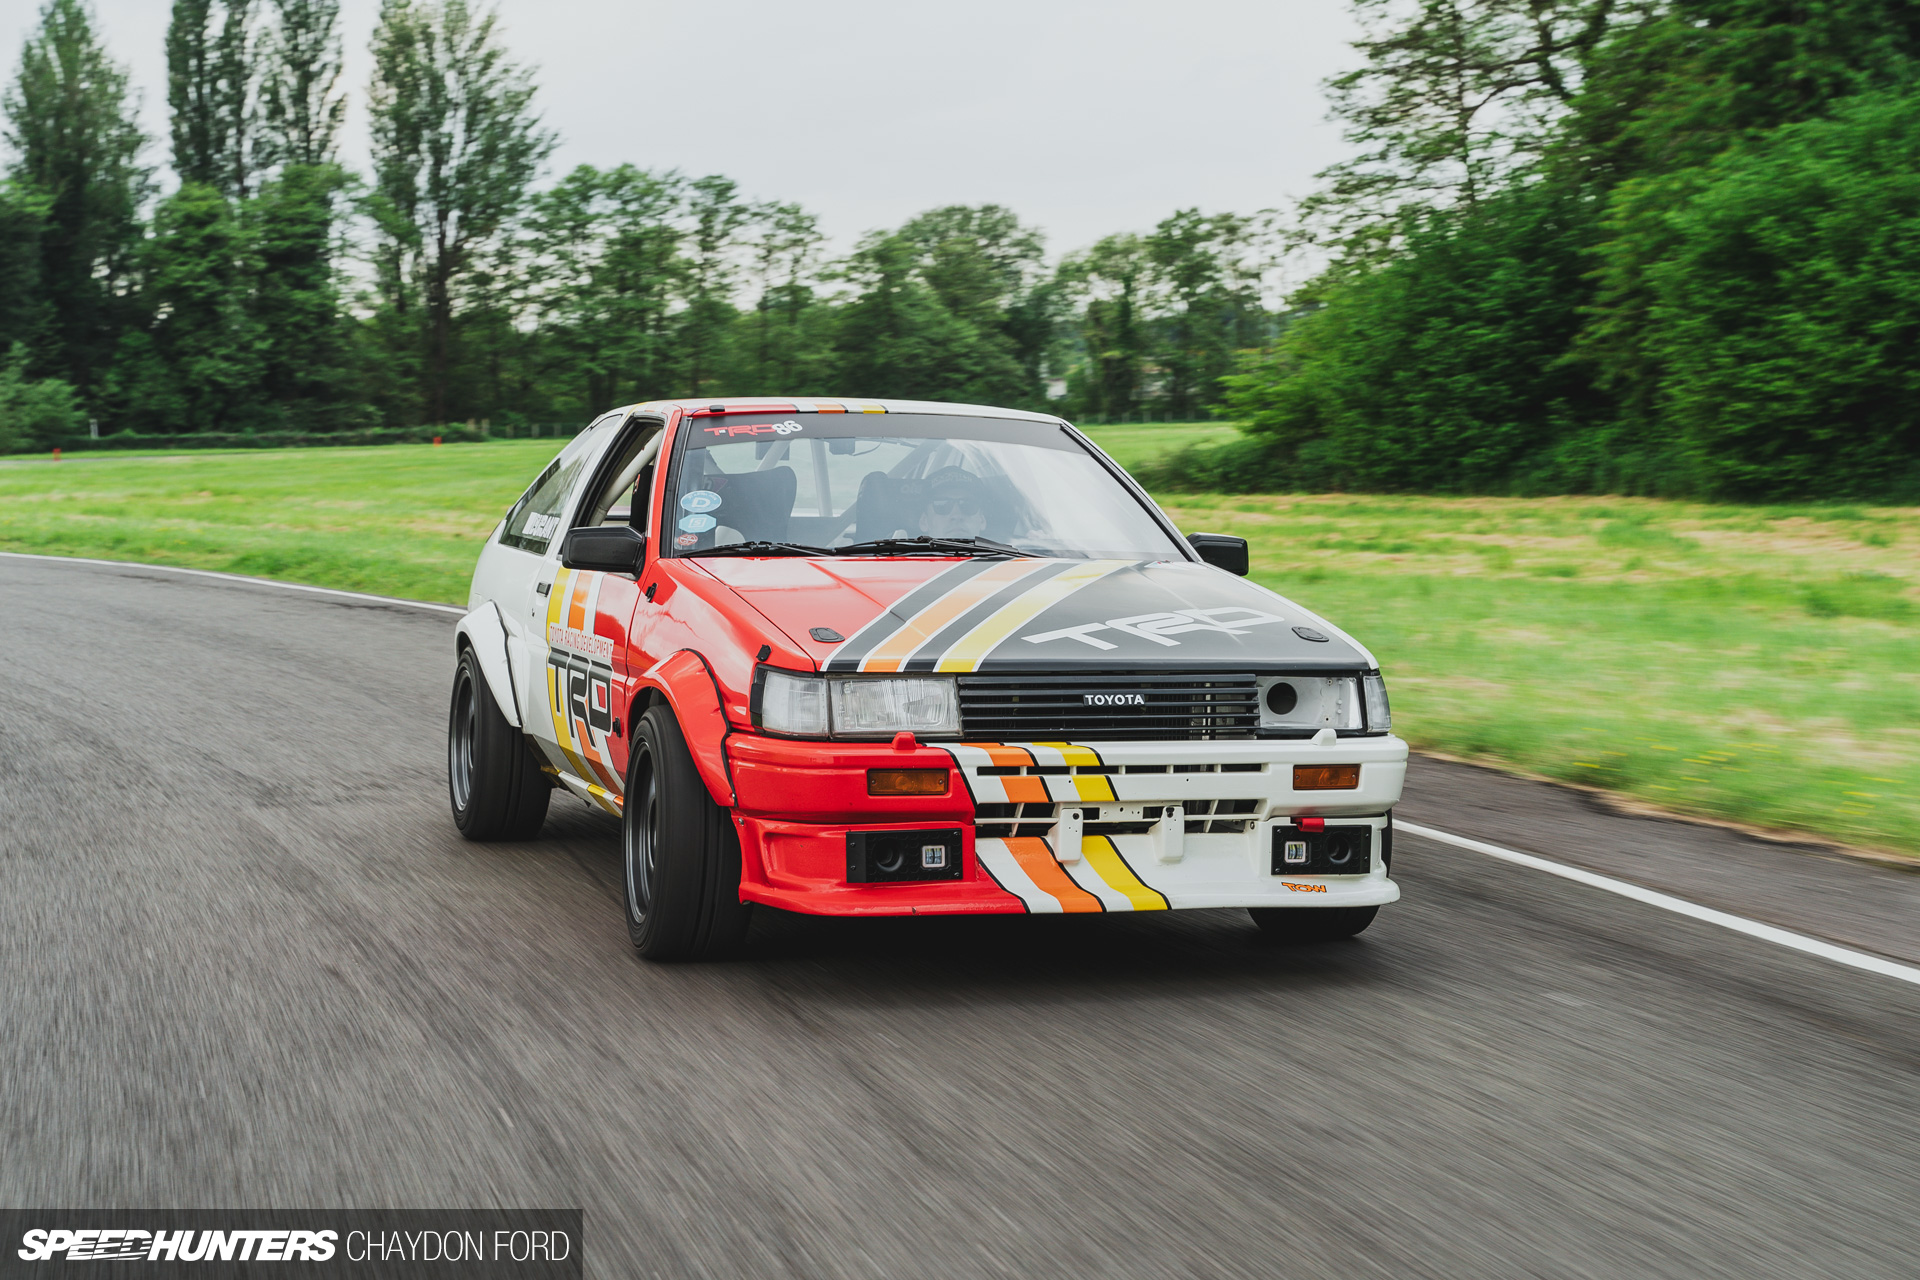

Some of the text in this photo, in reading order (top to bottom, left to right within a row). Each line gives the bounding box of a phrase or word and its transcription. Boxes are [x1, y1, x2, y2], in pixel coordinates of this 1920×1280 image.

[1021, 606, 1285, 651] TRD
[547, 646, 613, 749] TRD
[1085, 694, 1145, 706] TOYOTA
[1281, 881, 1327, 893] TOW
